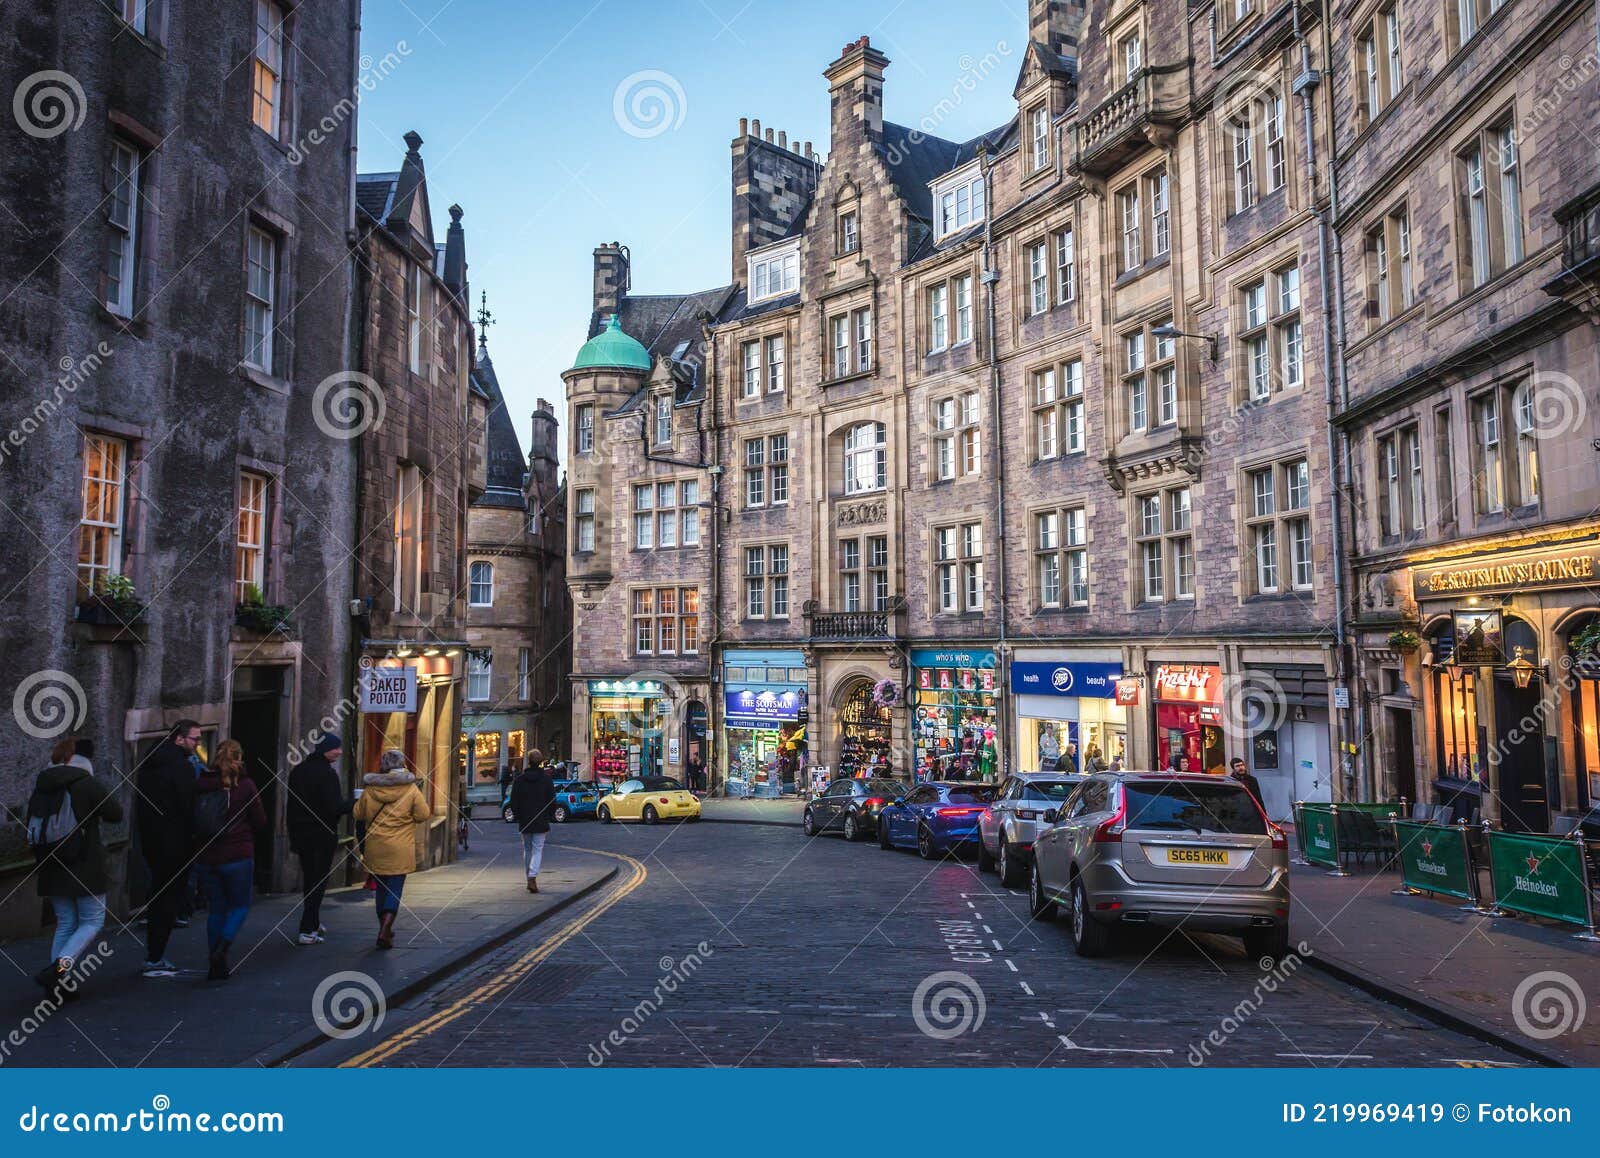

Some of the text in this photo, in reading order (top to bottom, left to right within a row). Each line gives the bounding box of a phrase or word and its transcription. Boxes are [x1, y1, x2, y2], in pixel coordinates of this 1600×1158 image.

[1448, 563, 1528, 589] SCOTSMAN'S
[1528, 555, 1593, 583] LOUNGE
[936, 653, 970, 661] who's who
[921, 671, 992, 689] SALE
[1023, 674, 1106, 686] health beauty
[1155, 667, 1212, 688] Pizza Hut
[370, 692, 406, 704] POTATO
[741, 699, 793, 709] THE SCOTSMAN
[1171, 850, 1224, 863] SC65 HKK
[1416, 858, 1448, 876] Heineken
[1515, 876, 1559, 897] Heineken
